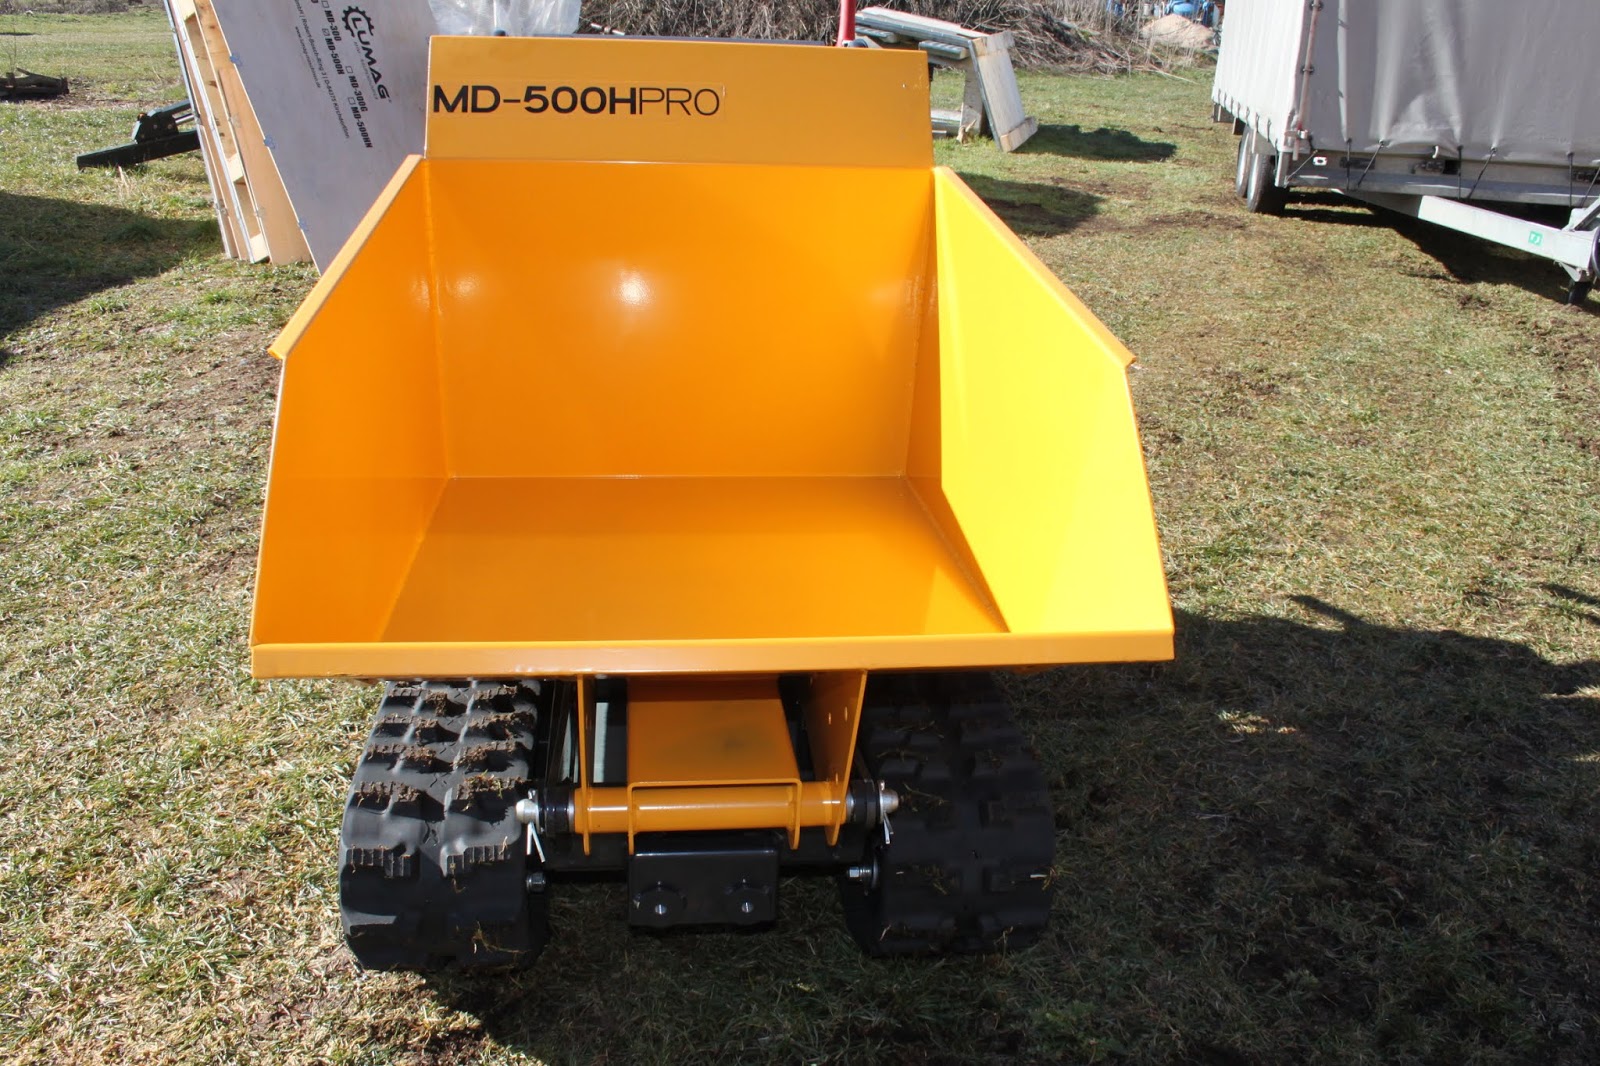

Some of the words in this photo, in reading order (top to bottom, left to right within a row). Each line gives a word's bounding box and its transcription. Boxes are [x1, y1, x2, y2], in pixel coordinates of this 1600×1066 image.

[324, 10, 342, 42] MD-300
[325, 38, 345, 75] MD-500H
[350, 17, 390, 99] LUMAG
[348, 75, 368, 112] MD-300G
